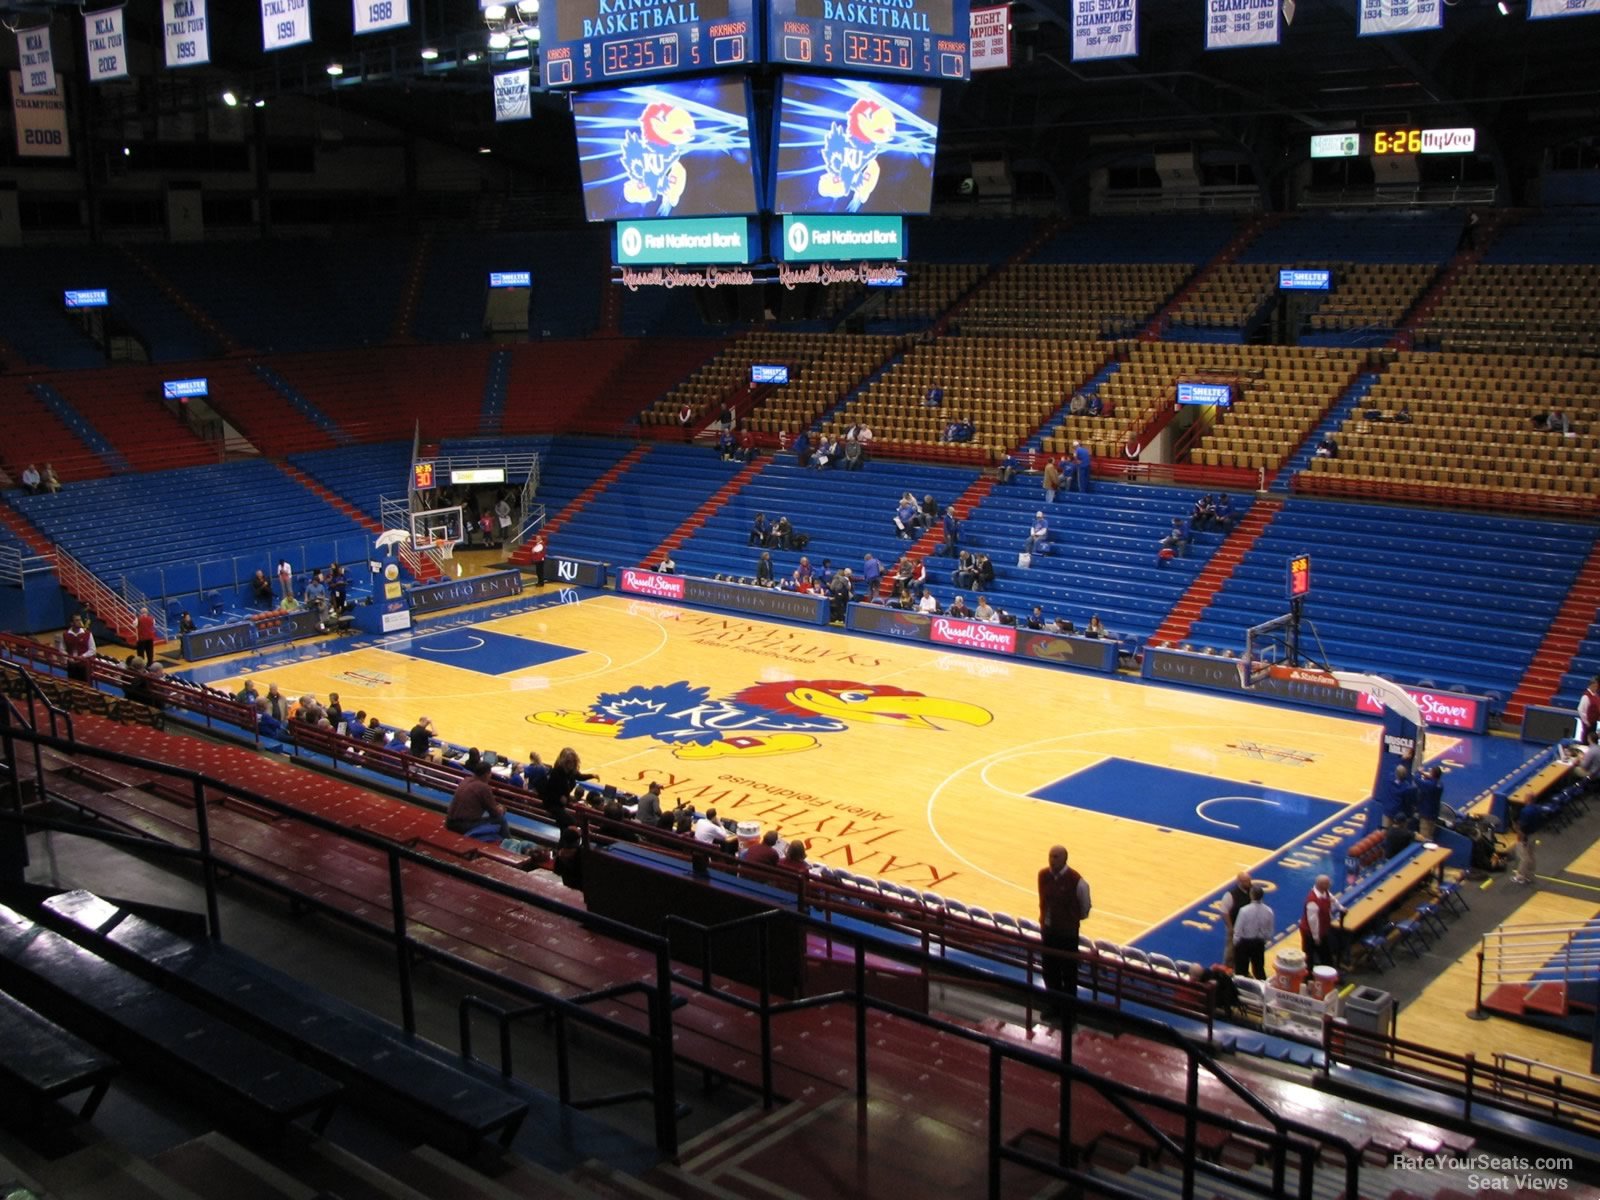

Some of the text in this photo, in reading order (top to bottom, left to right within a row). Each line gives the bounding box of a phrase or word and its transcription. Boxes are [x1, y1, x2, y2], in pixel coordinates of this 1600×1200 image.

[173, 0, 195, 19] NCAA
[369, 4, 392, 23] 1988
[600, 0, 678, 14] KAN
[1079, 1, 1095, 13] BIG
[1211, 0, 1274, 13] CHAMPIONS
[1417, 3, 1435, 13] 1937
[583, 3, 699, 38] BASKETBALL
[824, 1, 930, 32] BASKETBALL
[974, 12, 1001, 25] EIGHT
[1076, 10, 1133, 26] CHAMPIONS
[1234, 13, 1251, 22] 1940
[1258, 11, 1273, 20] 1941
[166, 22, 186, 36] FINAL
[277, 22, 296, 40] 1991
[709, 22, 746, 37] ARKANSAS
[784, 22, 810, 35] KANSAS
[970, 24, 1004, 38] MPIONS
[1234, 23, 1251, 32] 1943
[177, 41, 196, 59] 1993
[547, 47, 570, 60] KANSAS
[608, 41, 654, 70] 32:35
[732, 39, 740, 60] 0
[800, 39, 809, 60] 0
[849, 36, 892, 63] 32:35
[98, 56, 117, 73] 2002
[15, 99, 65, 110] CHAMPIONS
[25, 129, 61, 145] 2008
[1374, 130, 1422, 153] 6:26
[643, 153, 664, 175] KU
[844, 150, 863, 172] KU
[645, 234, 664, 248] First
[665, 233, 711, 248] National
[713, 232, 741, 247] Bank
[812, 230, 831, 244] First
[832, 230, 873, 244] National
[874, 230, 897, 244] Bank
[622, 264, 754, 291] Russell Stover Candies
[778, 260, 897, 290] Russell Stover Candies
[1294, 272, 1327, 280] SHELTER
[176, 380, 206, 390] SHELTER
[1193, 387, 1227, 396] SHELTER
[417, 472, 431, 487] 30
[558, 560, 579, 581] KU
[624, 571, 681, 592] Russell Stover
[642, 588, 677, 598] CANDIES
[934, 618, 1012, 643] Russell Stover
[205, 633, 237, 649] PAY
[687, 628, 893, 667] JAYHAWKS
[957, 638, 1006, 651] CANDIES
[1420, 694, 1467, 719] Stover
[665, 703, 771, 729] KU
[1425, 715, 1460, 726] DIES
[1385, 734, 1414, 749] MUSCLE
[717, 773, 895, 822] Allen Fieldhouse
